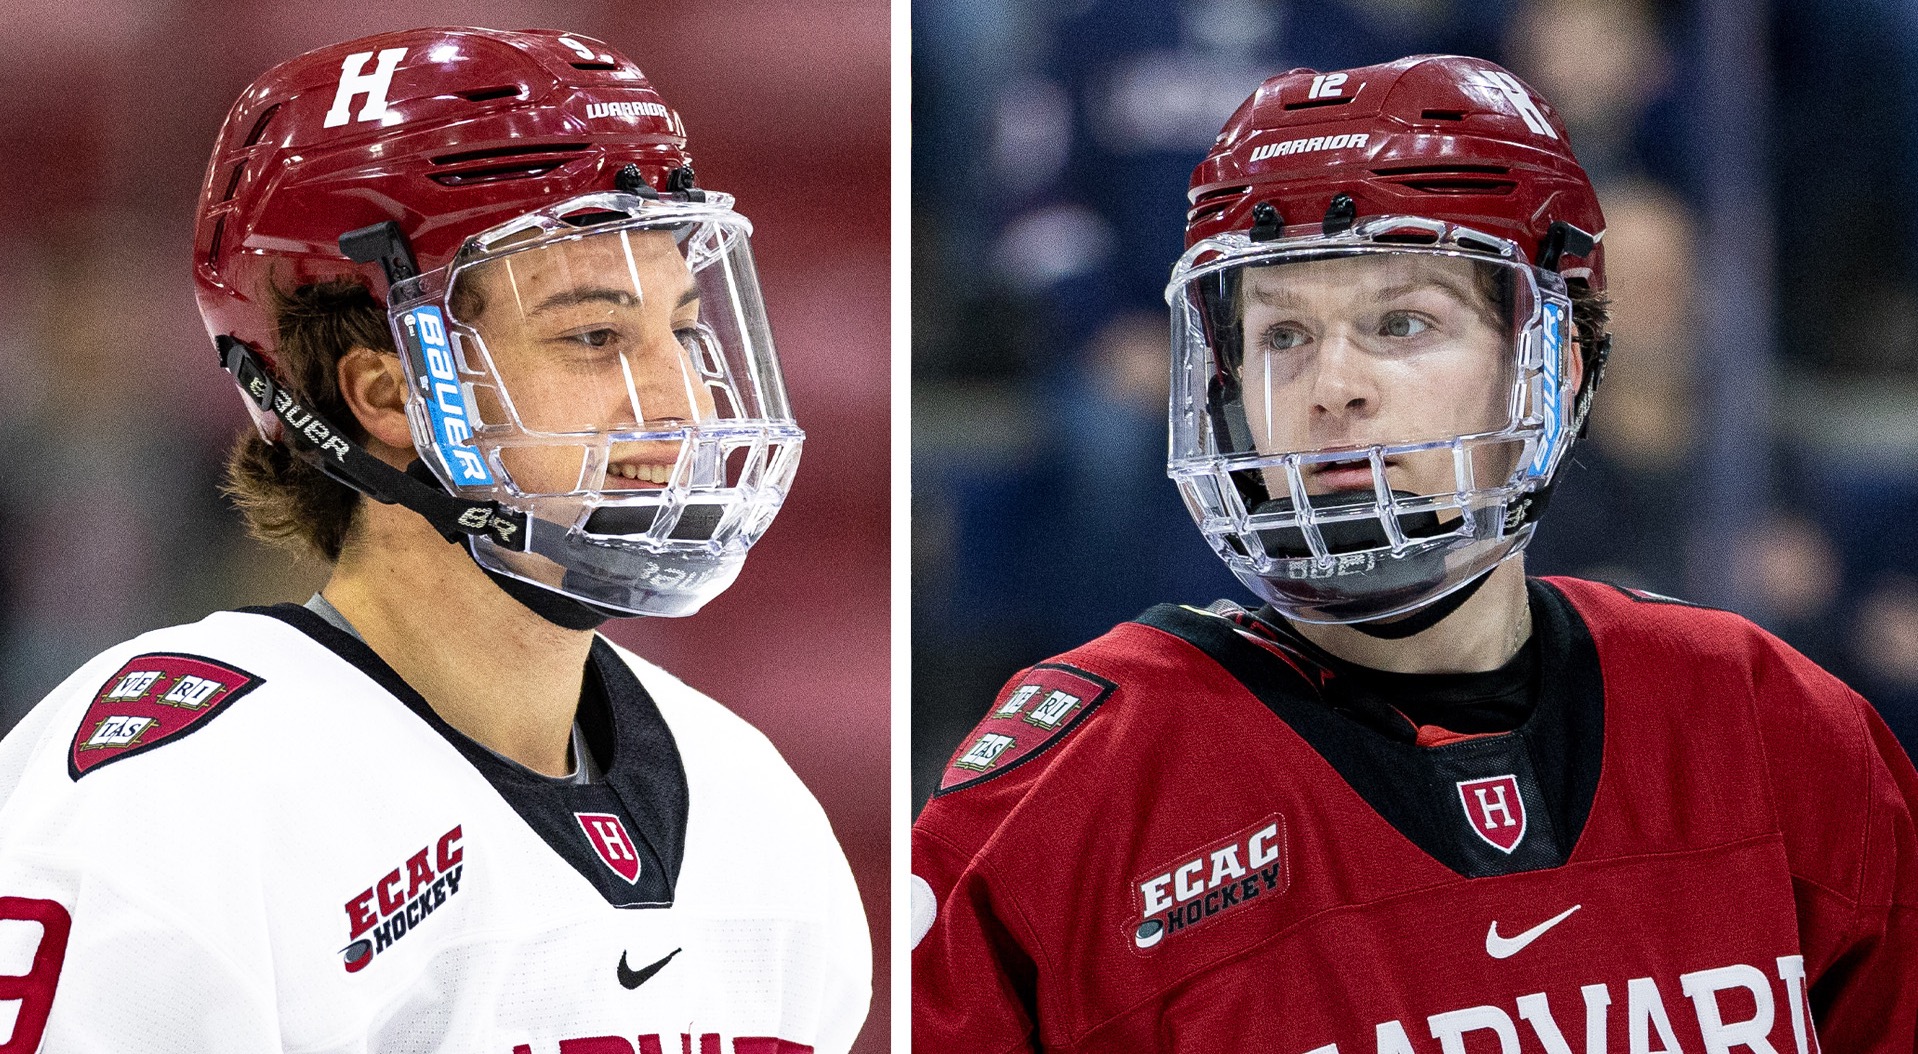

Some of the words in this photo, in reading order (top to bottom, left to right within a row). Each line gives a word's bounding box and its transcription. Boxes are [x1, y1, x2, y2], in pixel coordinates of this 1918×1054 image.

[323, 47, 409, 128] H
[1308, 73, 1348, 99] 12
[1478, 70, 1559, 140] H
[586, 102, 668, 119] WARRIOR
[1250, 134, 1370, 162] WARRIOR
[121, 677, 151, 693] VE
[173, 681, 208, 700] RI
[1037, 697, 1068, 718] RI
[99, 722, 141, 738] TAS
[970, 740, 1003, 760] TAS
[1473, 785, 1516, 830] H
[591, 821, 634, 861] H
[345, 824, 463, 941] ECAC
[1140, 823, 1279, 918] ECAC
[373, 864, 463, 955] HOCKEY
[1166, 863, 1280, 934] HOCKEY
